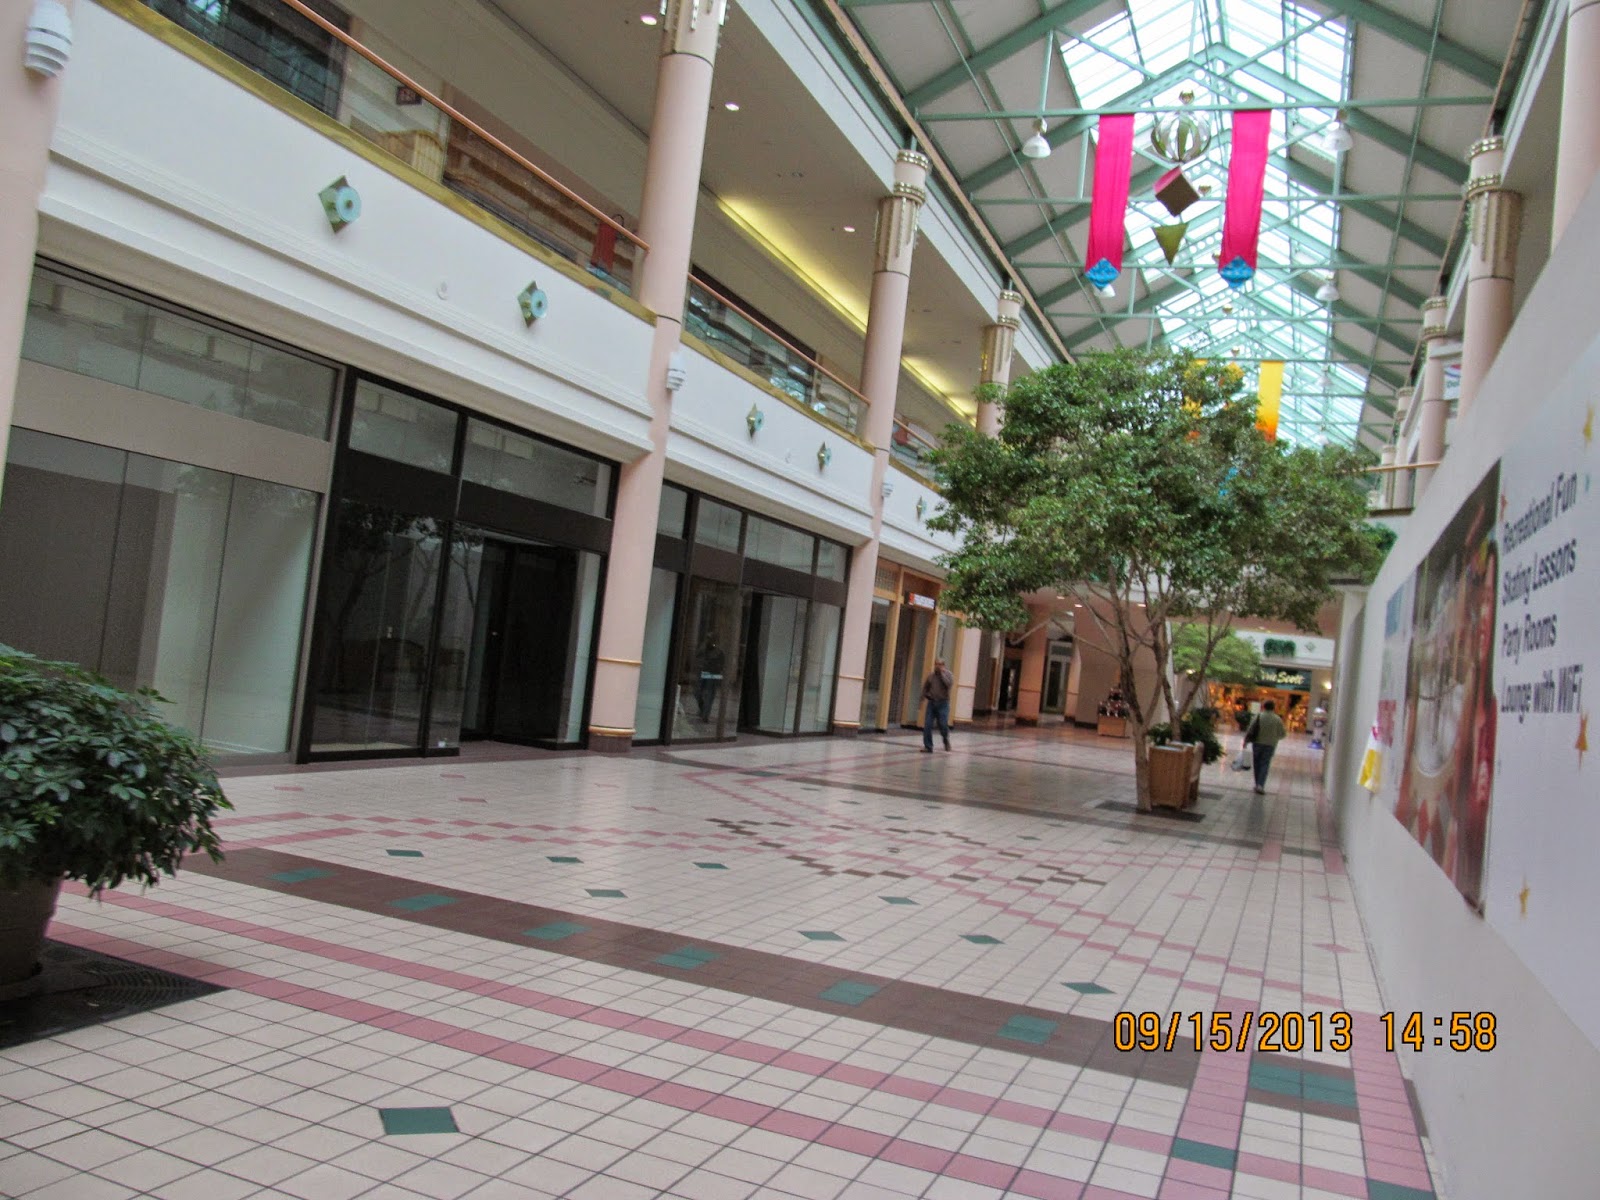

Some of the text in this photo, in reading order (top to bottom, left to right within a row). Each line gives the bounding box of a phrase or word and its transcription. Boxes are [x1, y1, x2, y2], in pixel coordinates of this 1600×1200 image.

[1502, 472, 1577, 556] Recreational Fun
[1502, 538, 1577, 606] Skating Lessons
[1501, 621, 1522, 665] Party
[1523, 613, 1557, 653] Rooms
[1501, 664, 1583, 724] Lounge with WiFi
